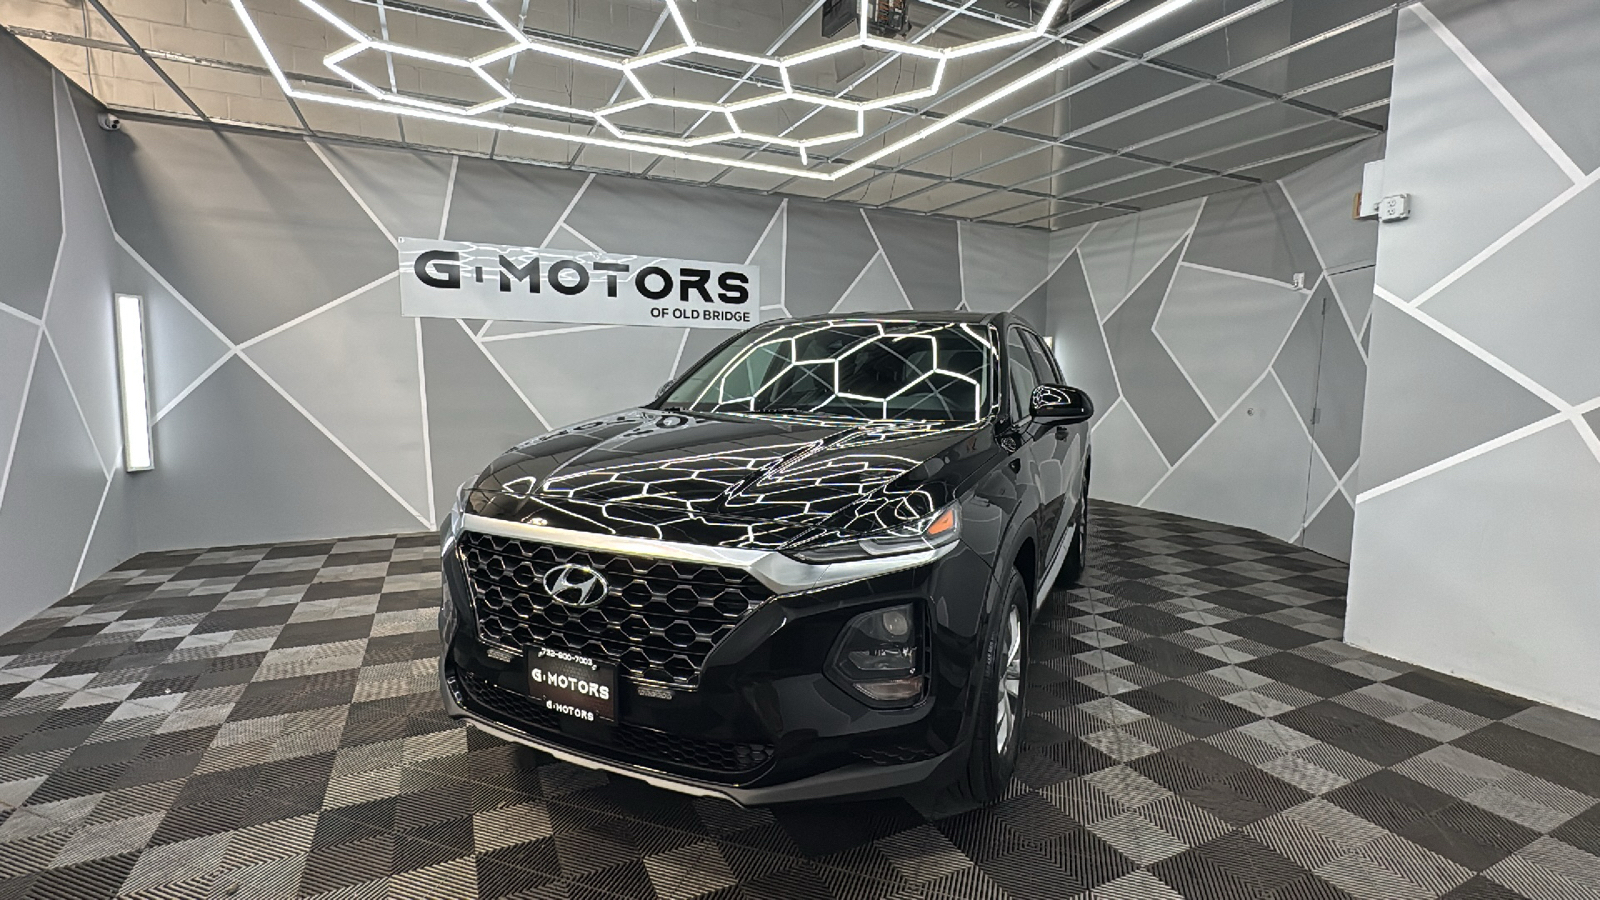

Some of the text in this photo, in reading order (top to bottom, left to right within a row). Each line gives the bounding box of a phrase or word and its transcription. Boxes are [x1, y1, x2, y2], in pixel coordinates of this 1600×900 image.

[650, 307, 751, 322] OF OLD BRIDGE
